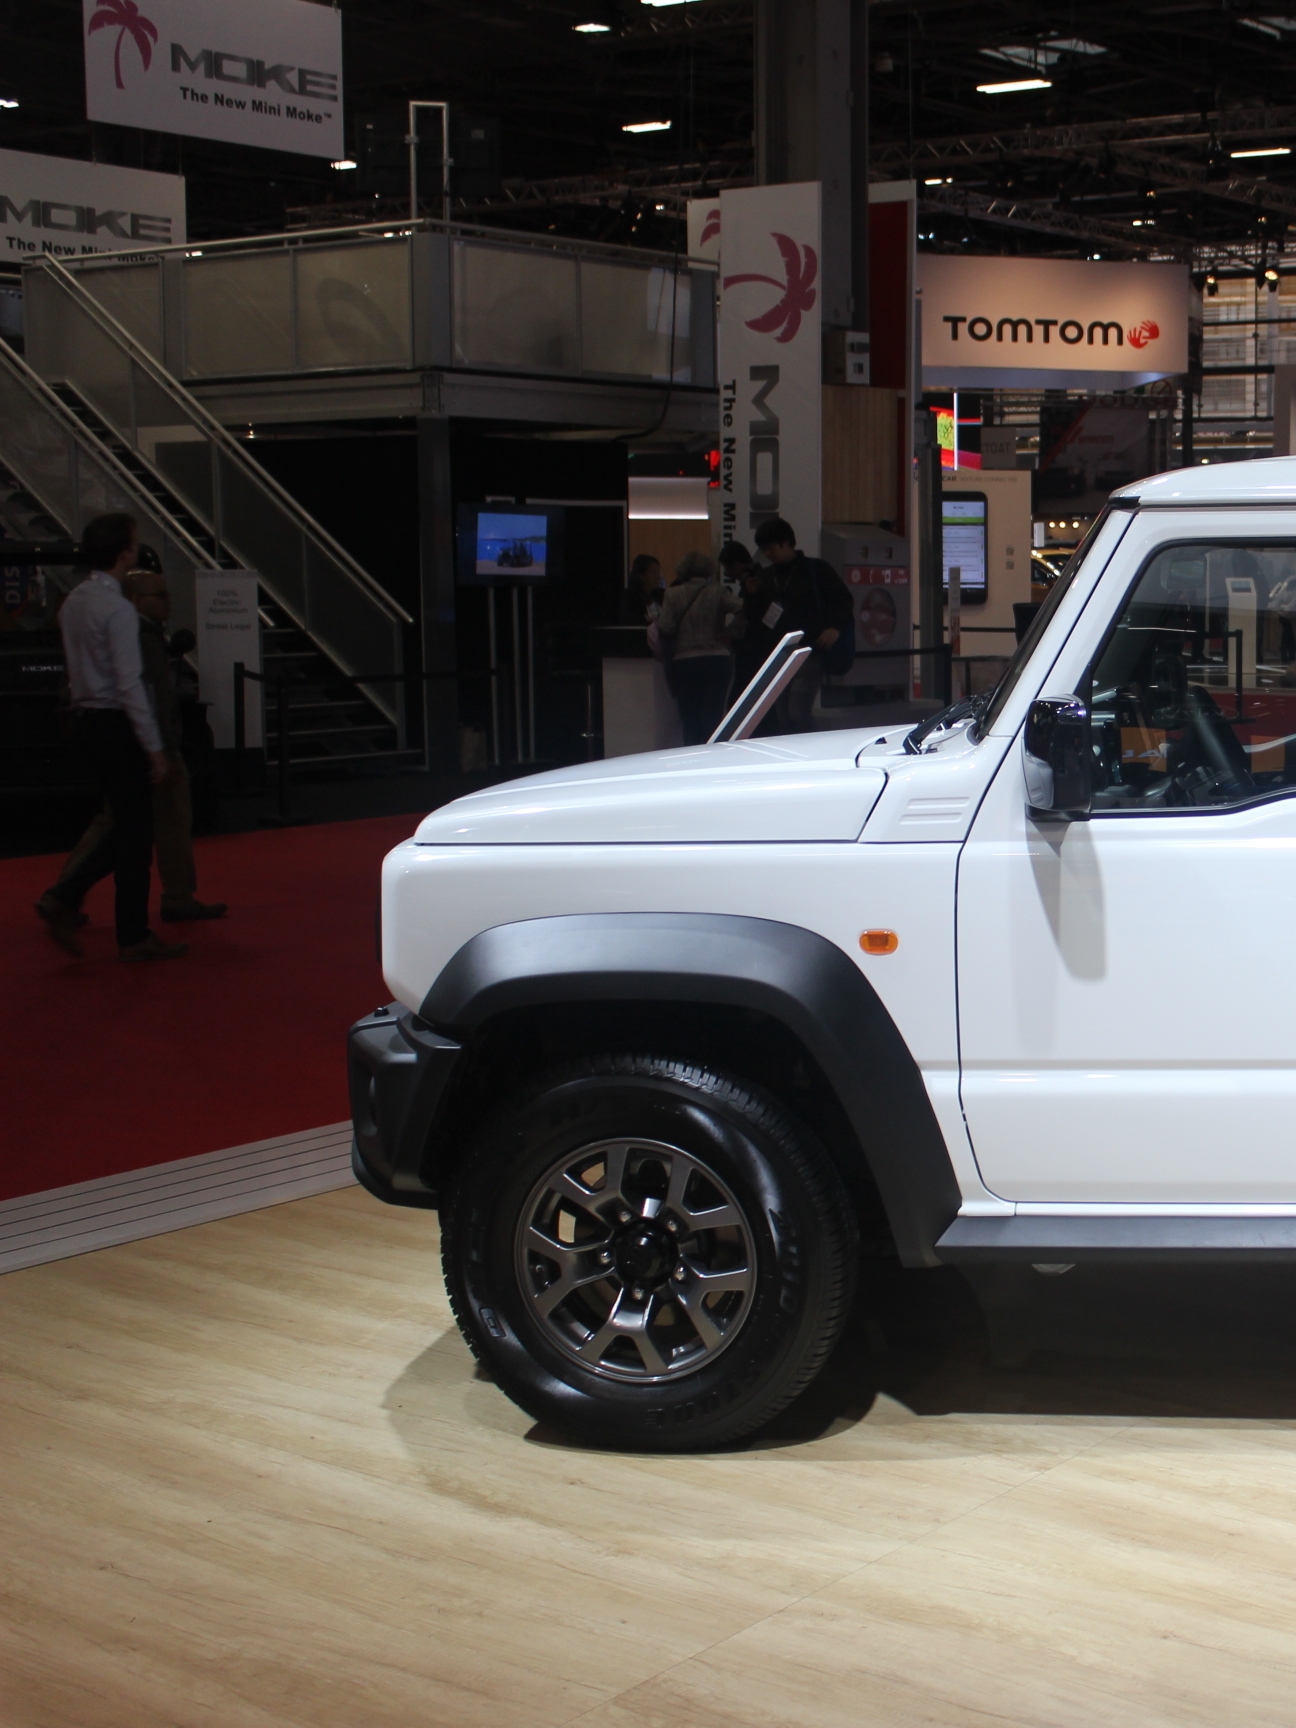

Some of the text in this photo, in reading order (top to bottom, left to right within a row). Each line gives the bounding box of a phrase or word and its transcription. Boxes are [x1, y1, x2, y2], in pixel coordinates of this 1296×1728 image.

[170, 42, 338, 103] MOKE
[179, 86, 209, 104] The
[214, 92, 247, 111] New
[251, 99, 282, 117] Mini
[0, 194, 172, 244] MOKE
[6, 236, 37, 252] The
[42, 241, 76, 256] New
[942, 315, 1124, 346] TOMTOM
[722, 378, 736, 548] The New Min
[749, 364, 780, 530] MO
[21, 664, 65, 672] MOKE
